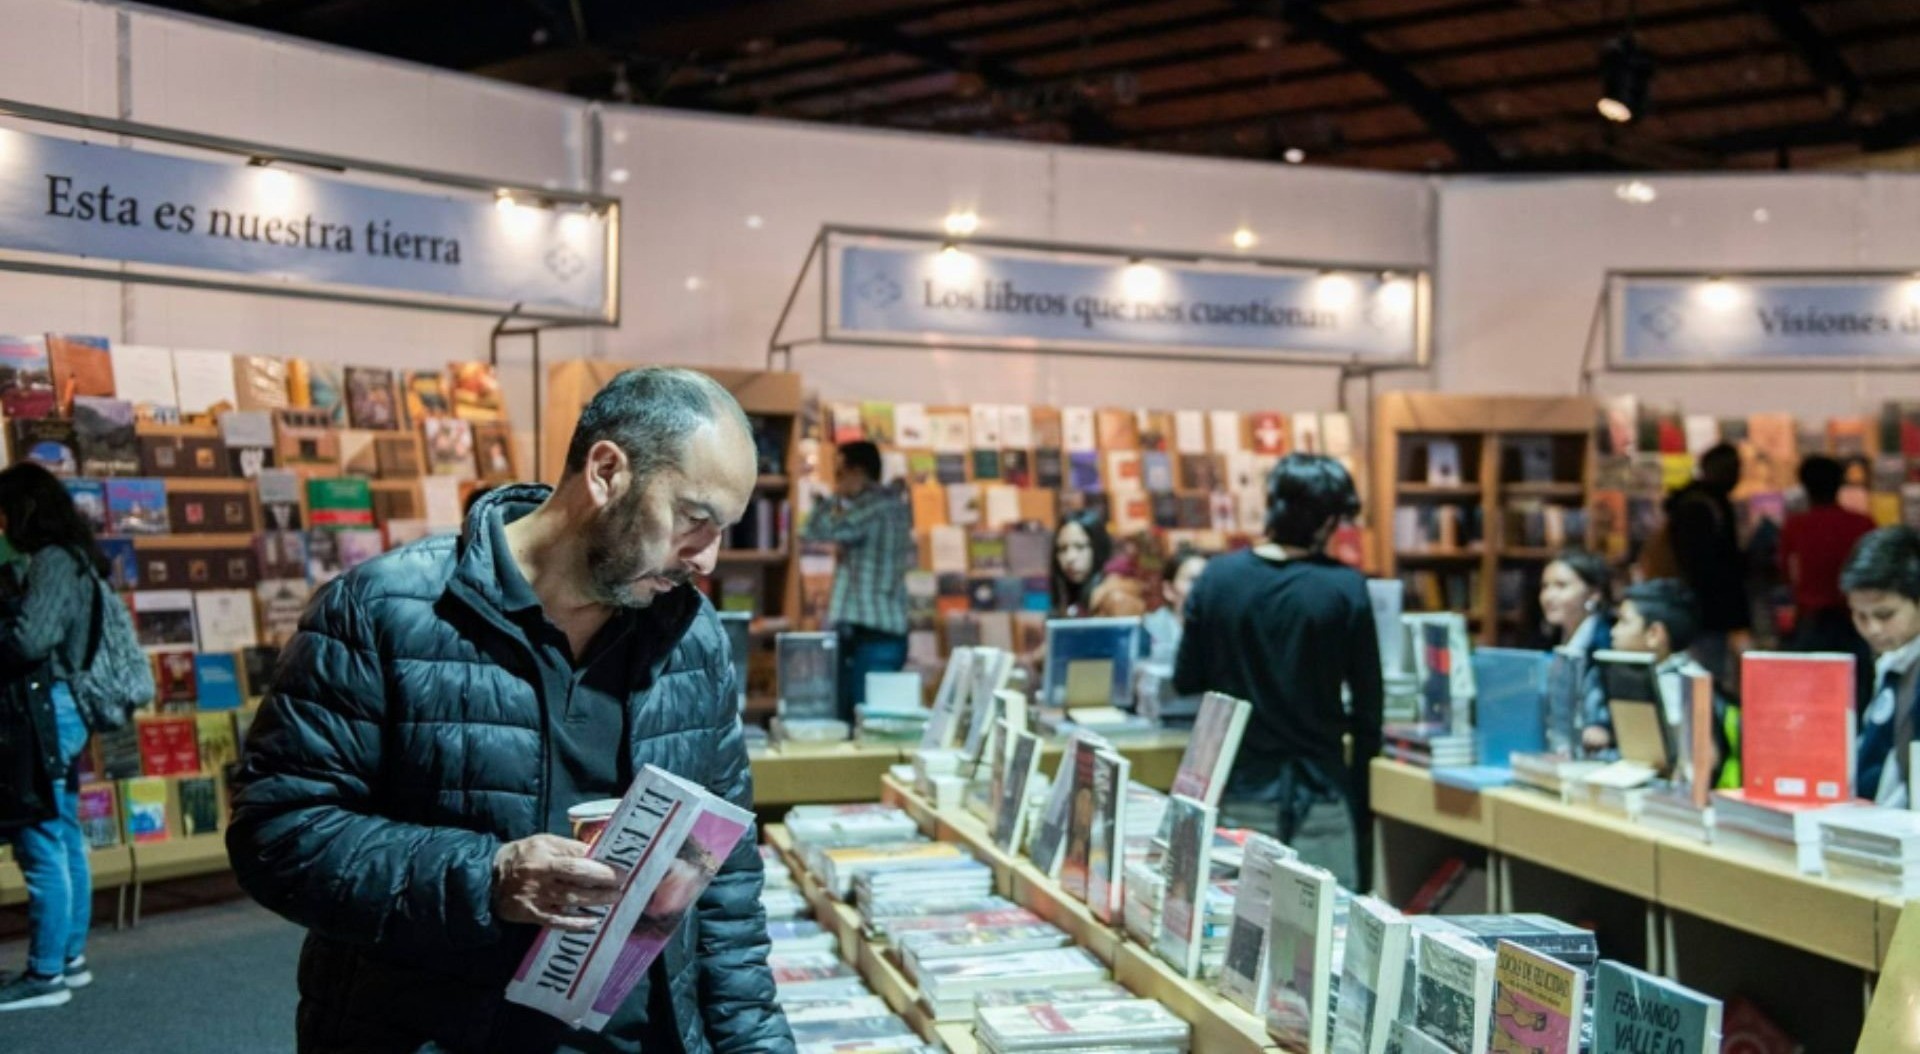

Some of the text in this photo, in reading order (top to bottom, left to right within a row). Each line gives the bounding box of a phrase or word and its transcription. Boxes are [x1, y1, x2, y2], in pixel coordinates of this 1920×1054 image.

[45, 174, 461, 265] Esta es nuestra tierra
[923, 281, 975, 309] Los
[984, 281, 1066, 315] libros
[1073, 294, 1127, 327] que
[1758, 306, 1889, 336] Visiones
[537, 788, 675, 994] EL ESTADOR
[1613, 990, 1680, 1032] FERNANDO
